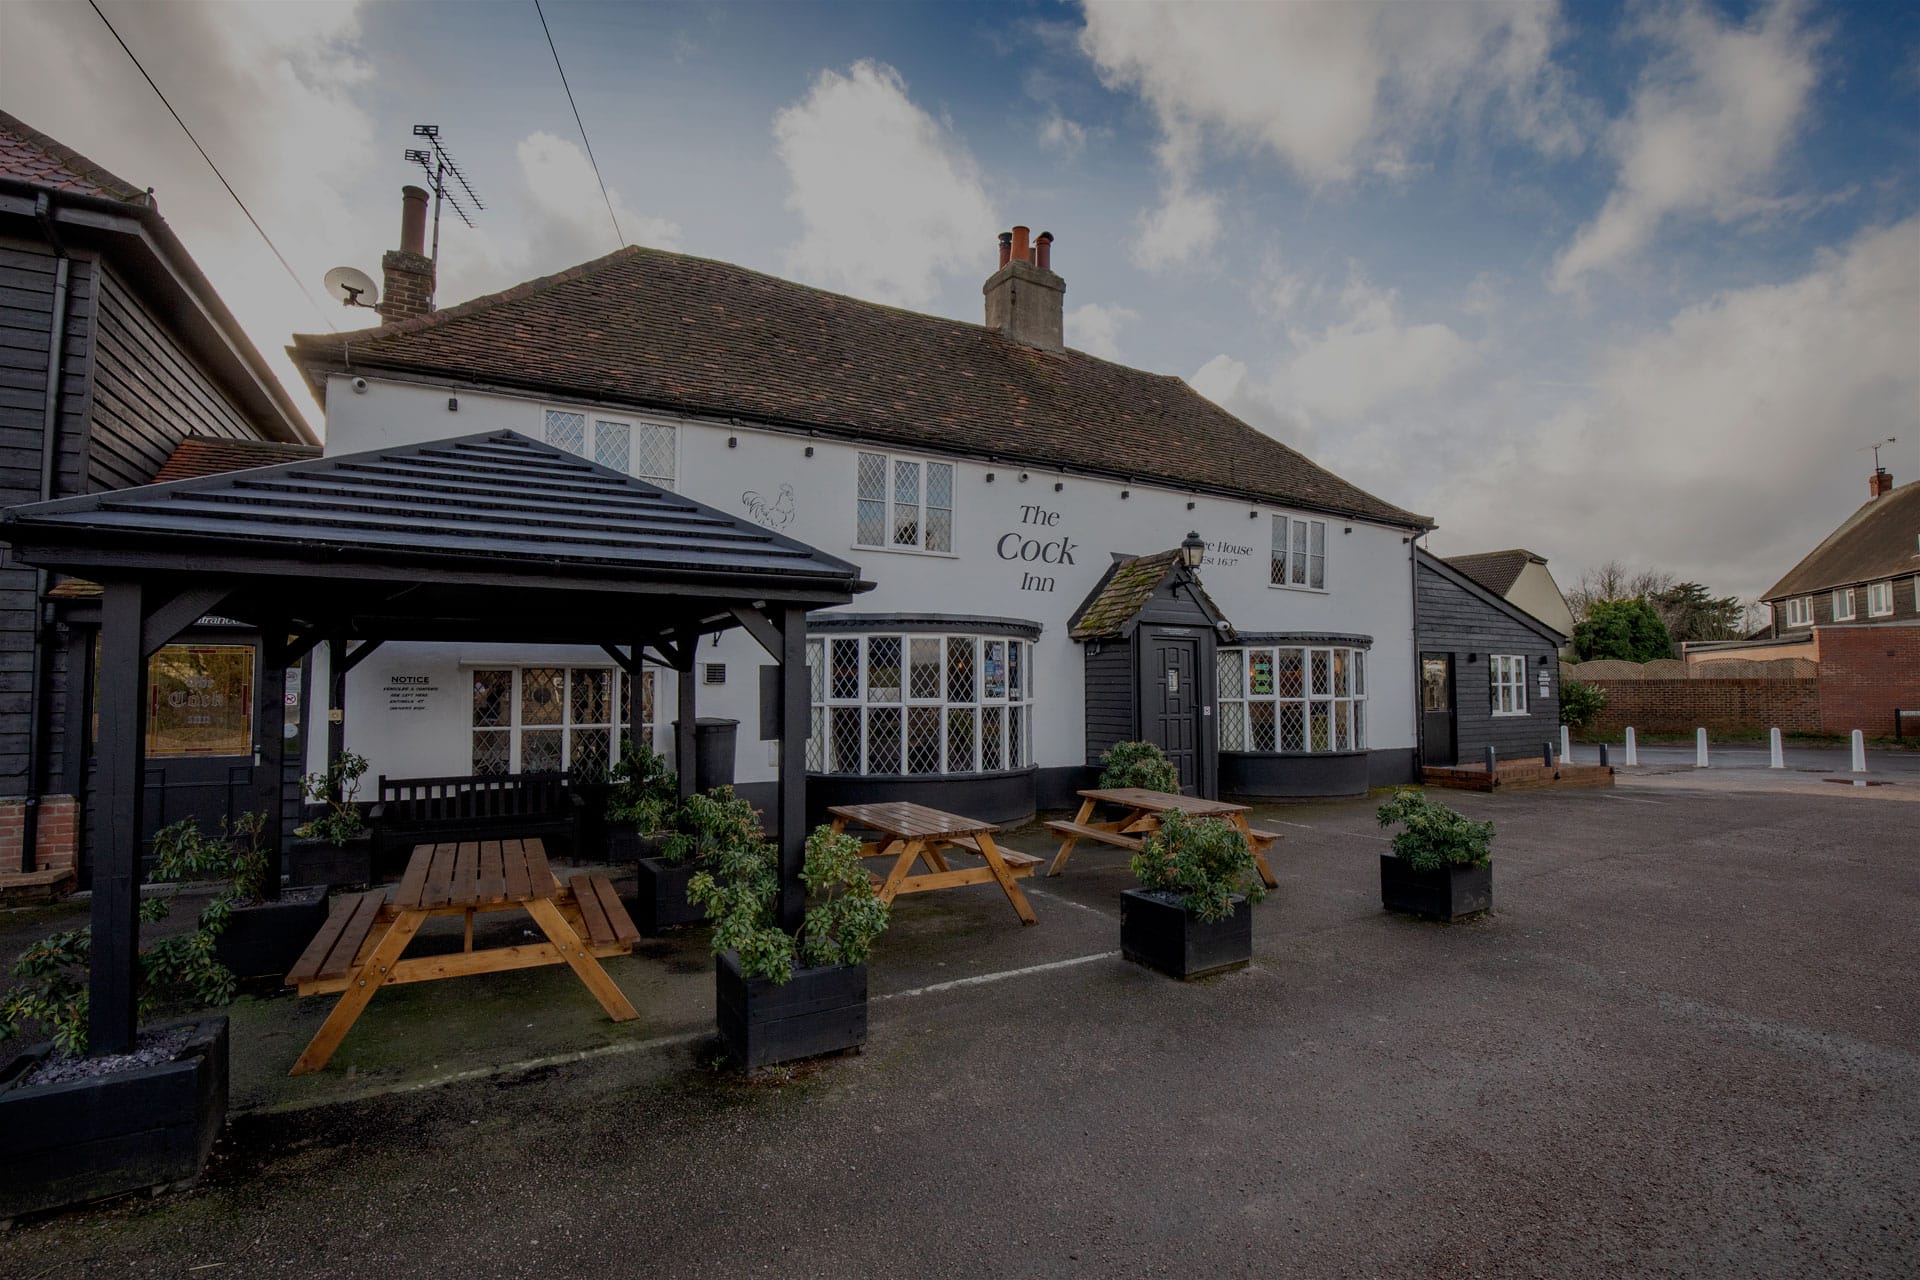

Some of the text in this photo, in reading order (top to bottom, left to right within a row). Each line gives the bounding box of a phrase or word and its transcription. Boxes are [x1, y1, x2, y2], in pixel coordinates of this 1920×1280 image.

[1020, 505, 1060, 527] The
[996, 532, 1079, 566] Cock
[1217, 541, 1254, 557] House
[1021, 572, 1056, 592] Inn
[168, 690, 224, 708] Cock
